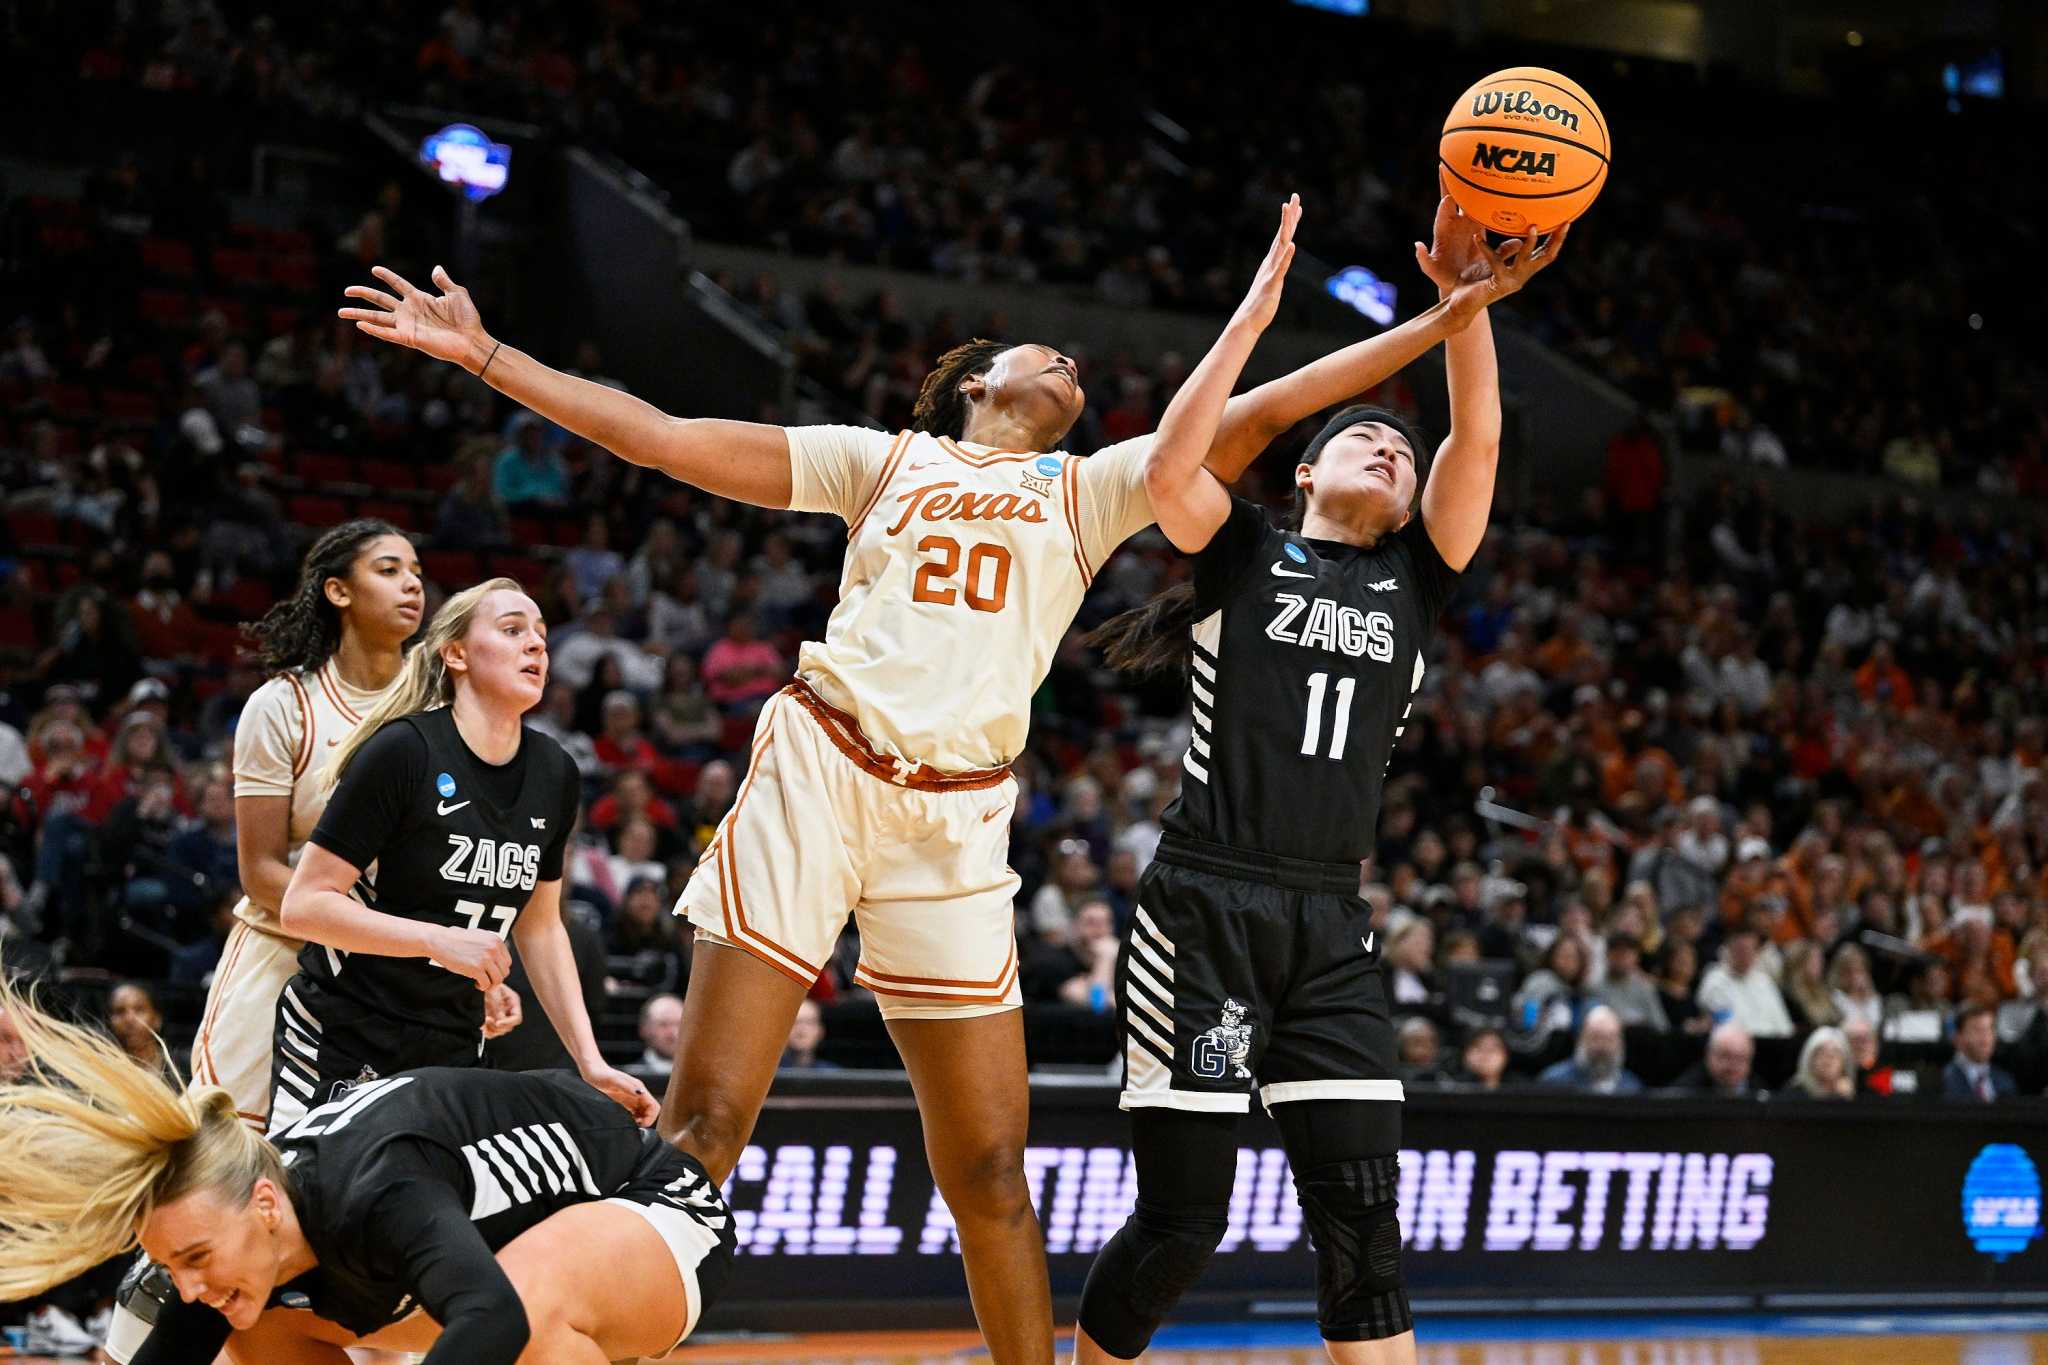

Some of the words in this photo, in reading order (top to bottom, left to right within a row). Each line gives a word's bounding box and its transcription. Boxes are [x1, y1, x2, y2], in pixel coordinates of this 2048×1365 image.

[1472, 91, 1579, 132] Wilson
[1471, 142, 1556, 177] NCAA
[886, 481, 1049, 537] Texas
[912, 535, 1013, 614] 20
[1264, 592, 1395, 664] ZAGS
[1300, 672, 1357, 760] 11
[438, 833, 541, 891] ZAGS
[724, 1145, 903, 1255] CALL
[1483, 1150, 1775, 1252] BETTING
